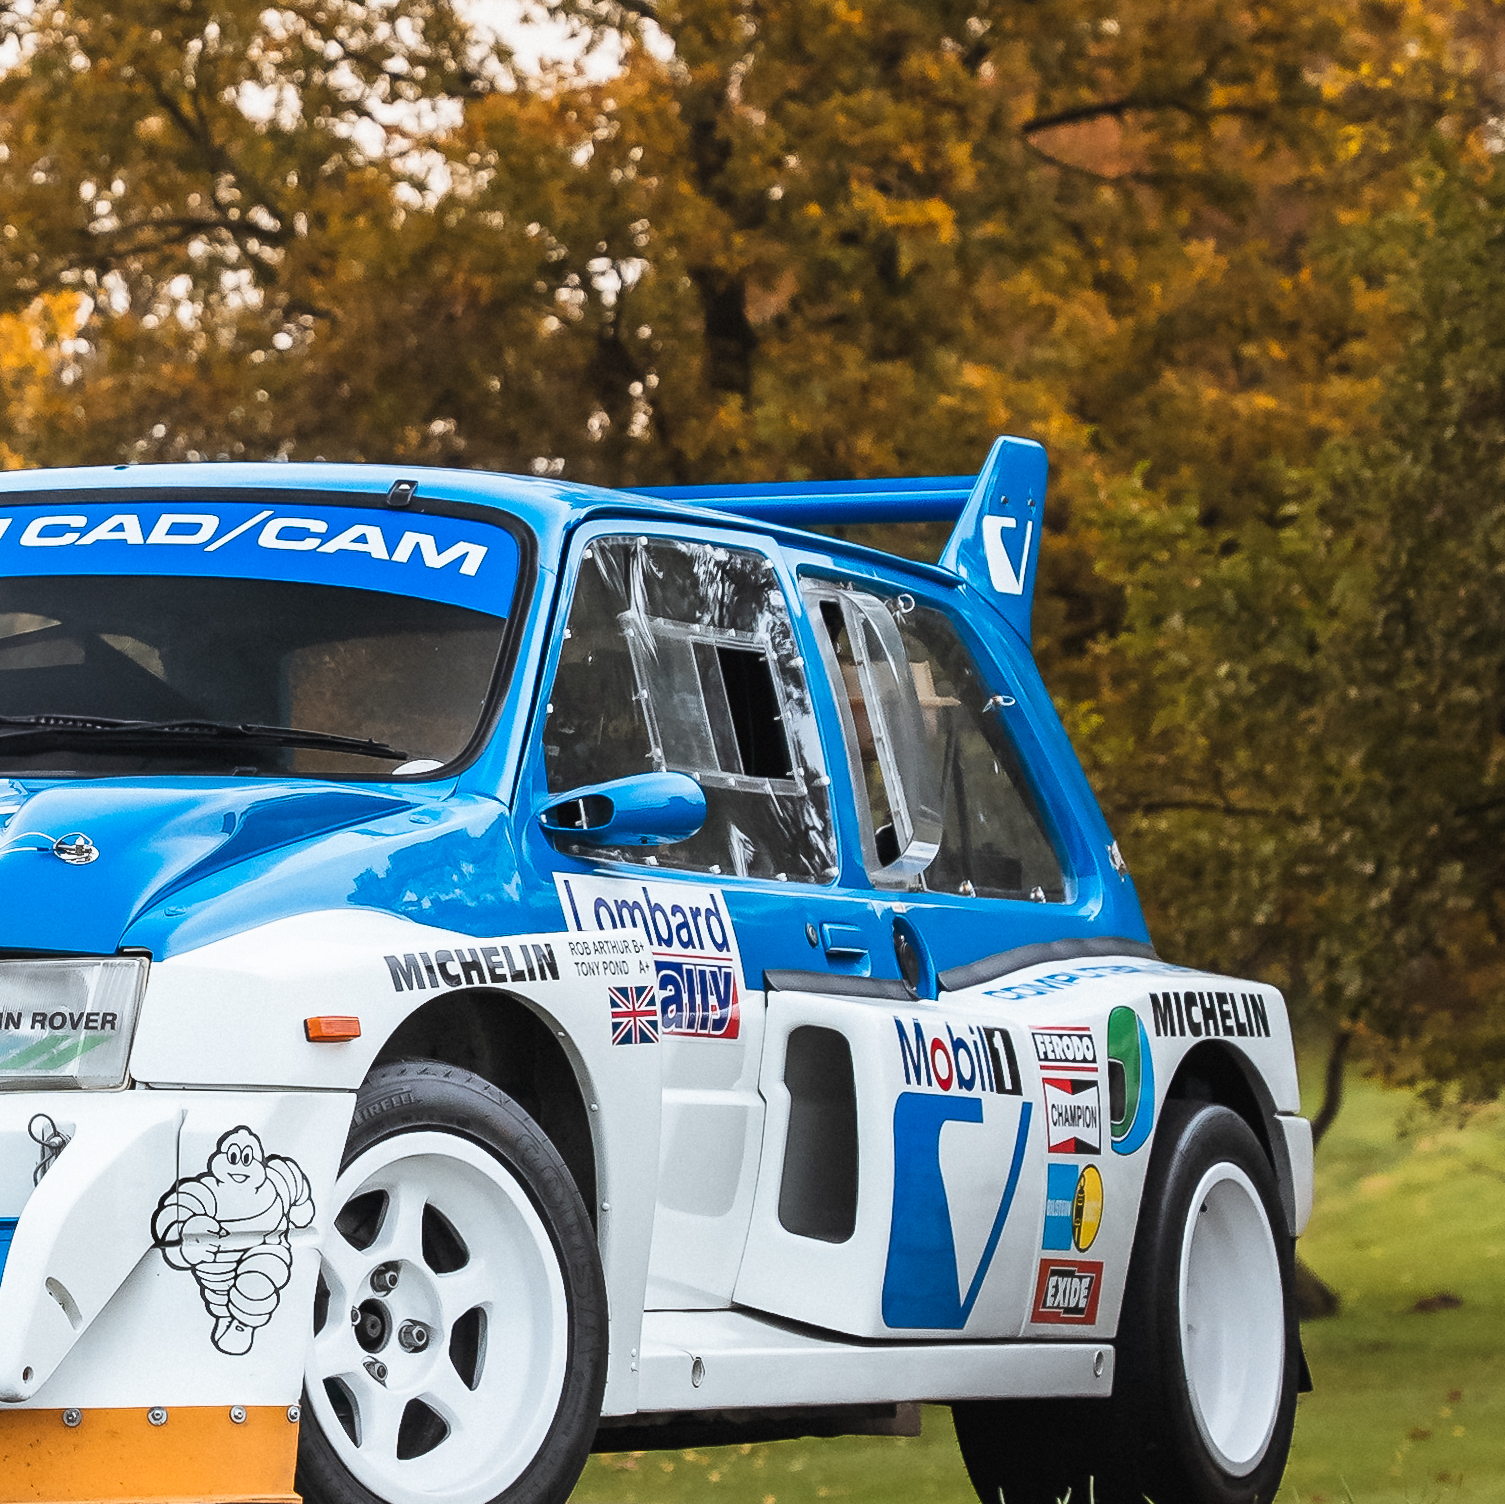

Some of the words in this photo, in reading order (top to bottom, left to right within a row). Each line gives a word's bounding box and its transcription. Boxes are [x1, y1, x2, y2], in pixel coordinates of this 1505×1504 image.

[19, 510, 489, 577] CAD/CAM
[563, 879, 731, 953] Lombard
[383, 943, 561, 992] MICHELIN
[568, 941, 592, 956] ROB
[592, 939, 632, 955] ARTHUR
[574, 961, 601, 977] TONY
[602, 960, 630, 976] POND
[657, 964, 734, 1034] ally
[1149, 991, 1272, 1038] MICHELIN
[29, 1011, 118, 1031] ROVER
[893, 1016, 995, 1092] Mobil
[1034, 1033, 1095, 1062] FERODO
[1050, 1103, 1097, 1129] CHAMPION
[1046, 1275, 1091, 1310] EXIDE
